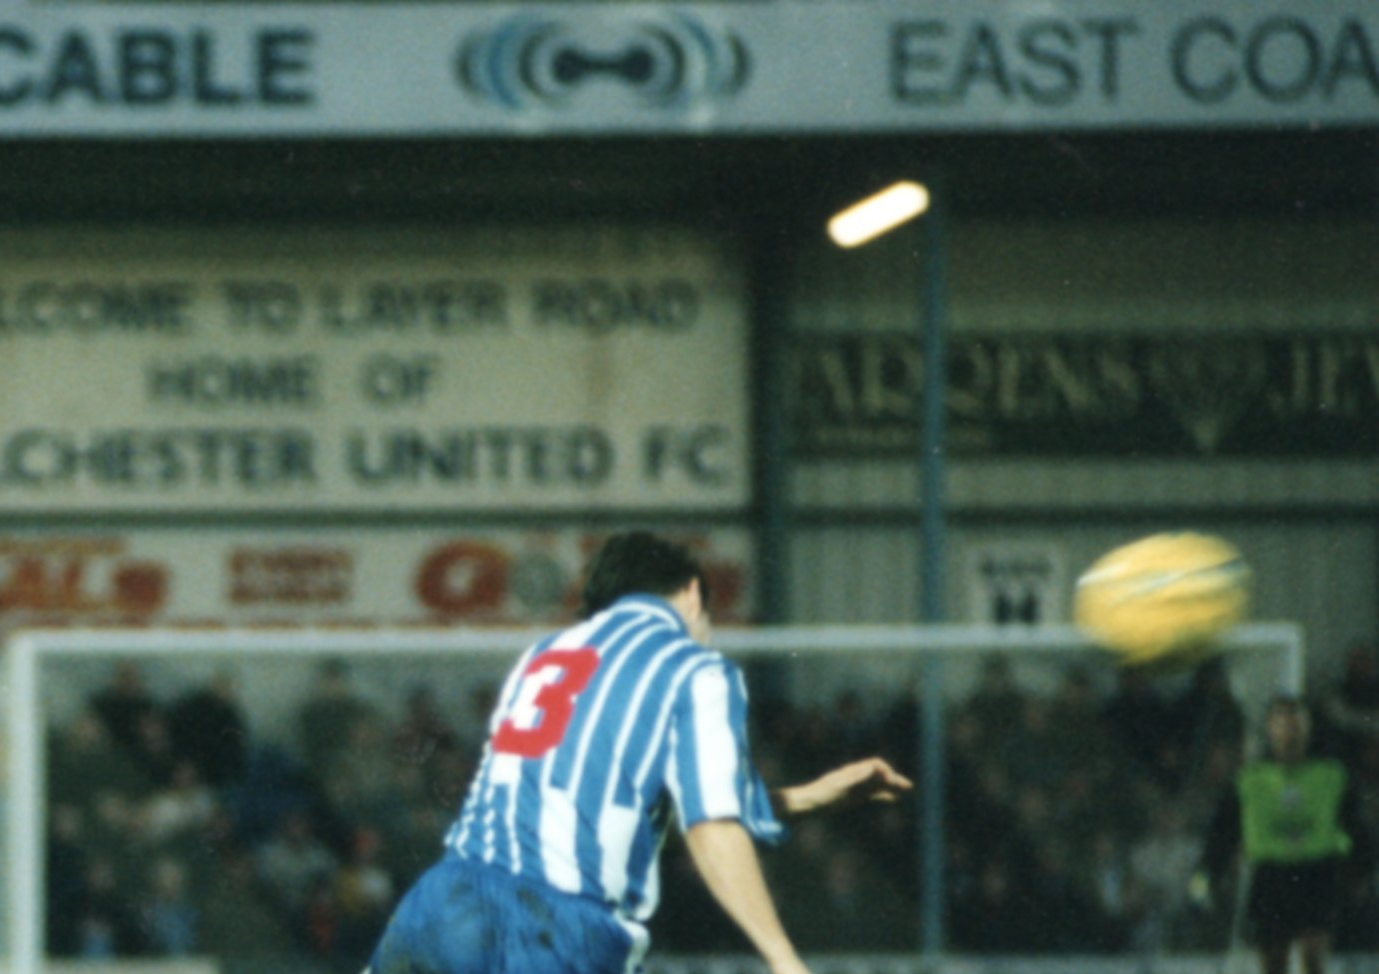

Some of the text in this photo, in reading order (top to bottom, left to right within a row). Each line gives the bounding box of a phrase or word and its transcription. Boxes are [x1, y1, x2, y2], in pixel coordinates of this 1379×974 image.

[889, 15, 1379, 104] EAST COA
[224, 280, 304, 334] TO
[324, 281, 512, 335] LAYER
[532, 279, 702, 334] ROAD
[147, 354, 438, 405] HOME OF
[346, 427, 614, 486] UNITED
[644, 425, 732, 488] FC
[491, 646, 600, 759] 3
